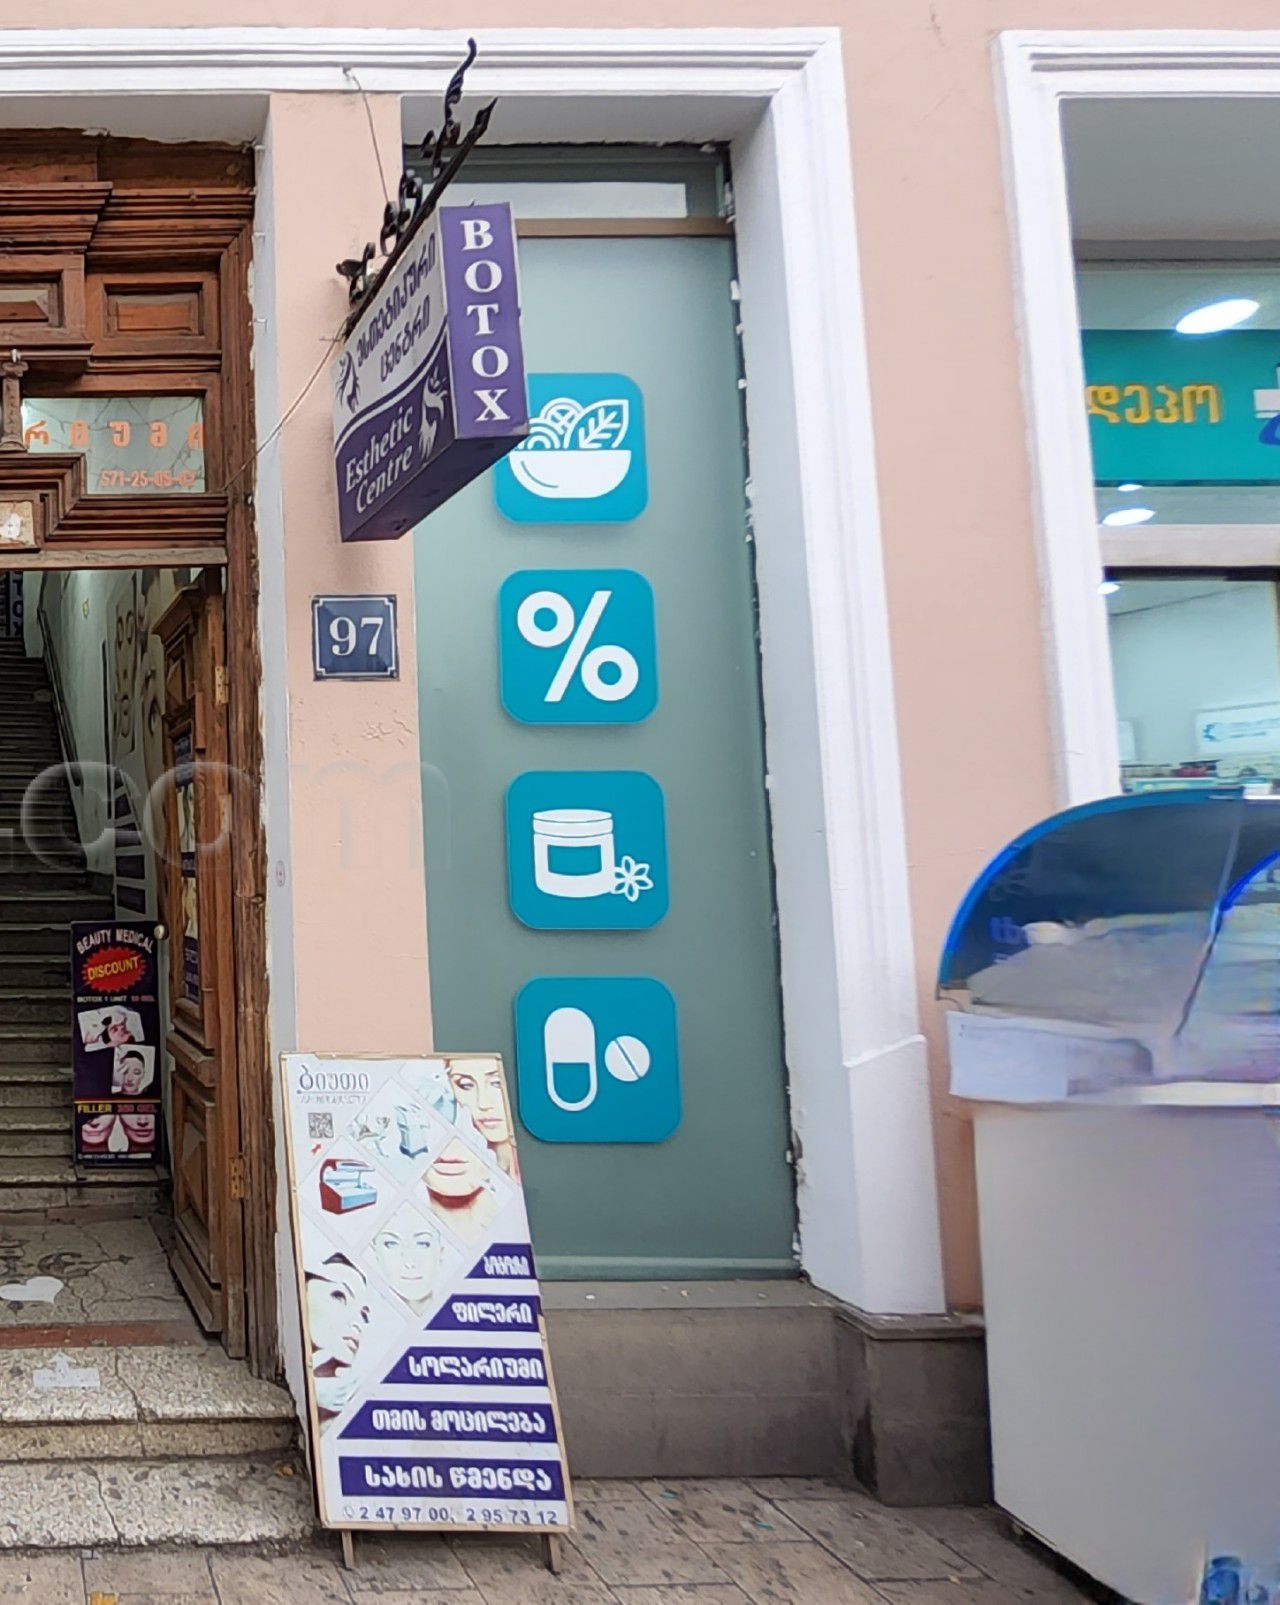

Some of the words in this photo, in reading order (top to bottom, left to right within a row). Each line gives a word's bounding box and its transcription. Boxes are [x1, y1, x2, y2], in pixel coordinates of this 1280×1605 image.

[460, 220, 510, 422] BOTOX
[381, 294, 430, 382] ცენტრი
[346, 405, 414, 493] Esthetic
[355, 445, 413, 514] Centre
[329, 616, 384, 656] 97
[76, 929, 112, 954] BEAUTY
[115, 928, 154, 954] MEDICAL
[87, 956, 140, 980] DISCOUNT
[299, 1064, 369, 1090] ბიუთი
[78, 1104, 112, 1114] FILLER
[451, 1302, 533, 1324] ფილერი
[408, 1355, 544, 1380] სოლარიუმი
[372, 1409, 427, 1431] თმის
[431, 1410, 547, 1434] მოცილება
[364, 1464, 443, 1488] სახის
[449, 1467, 552, 1492] წმენდა
[359, 1506, 369, 1520] 2
[375, 1506, 395, 1520] 47
[402, 1507, 421, 1520] 97
[466, 1508, 476, 1521] 2
[481, 1508, 503, 1523] 95
[509, 1509, 530, 1525] 73
[536, 1510, 558, 1526] 12
